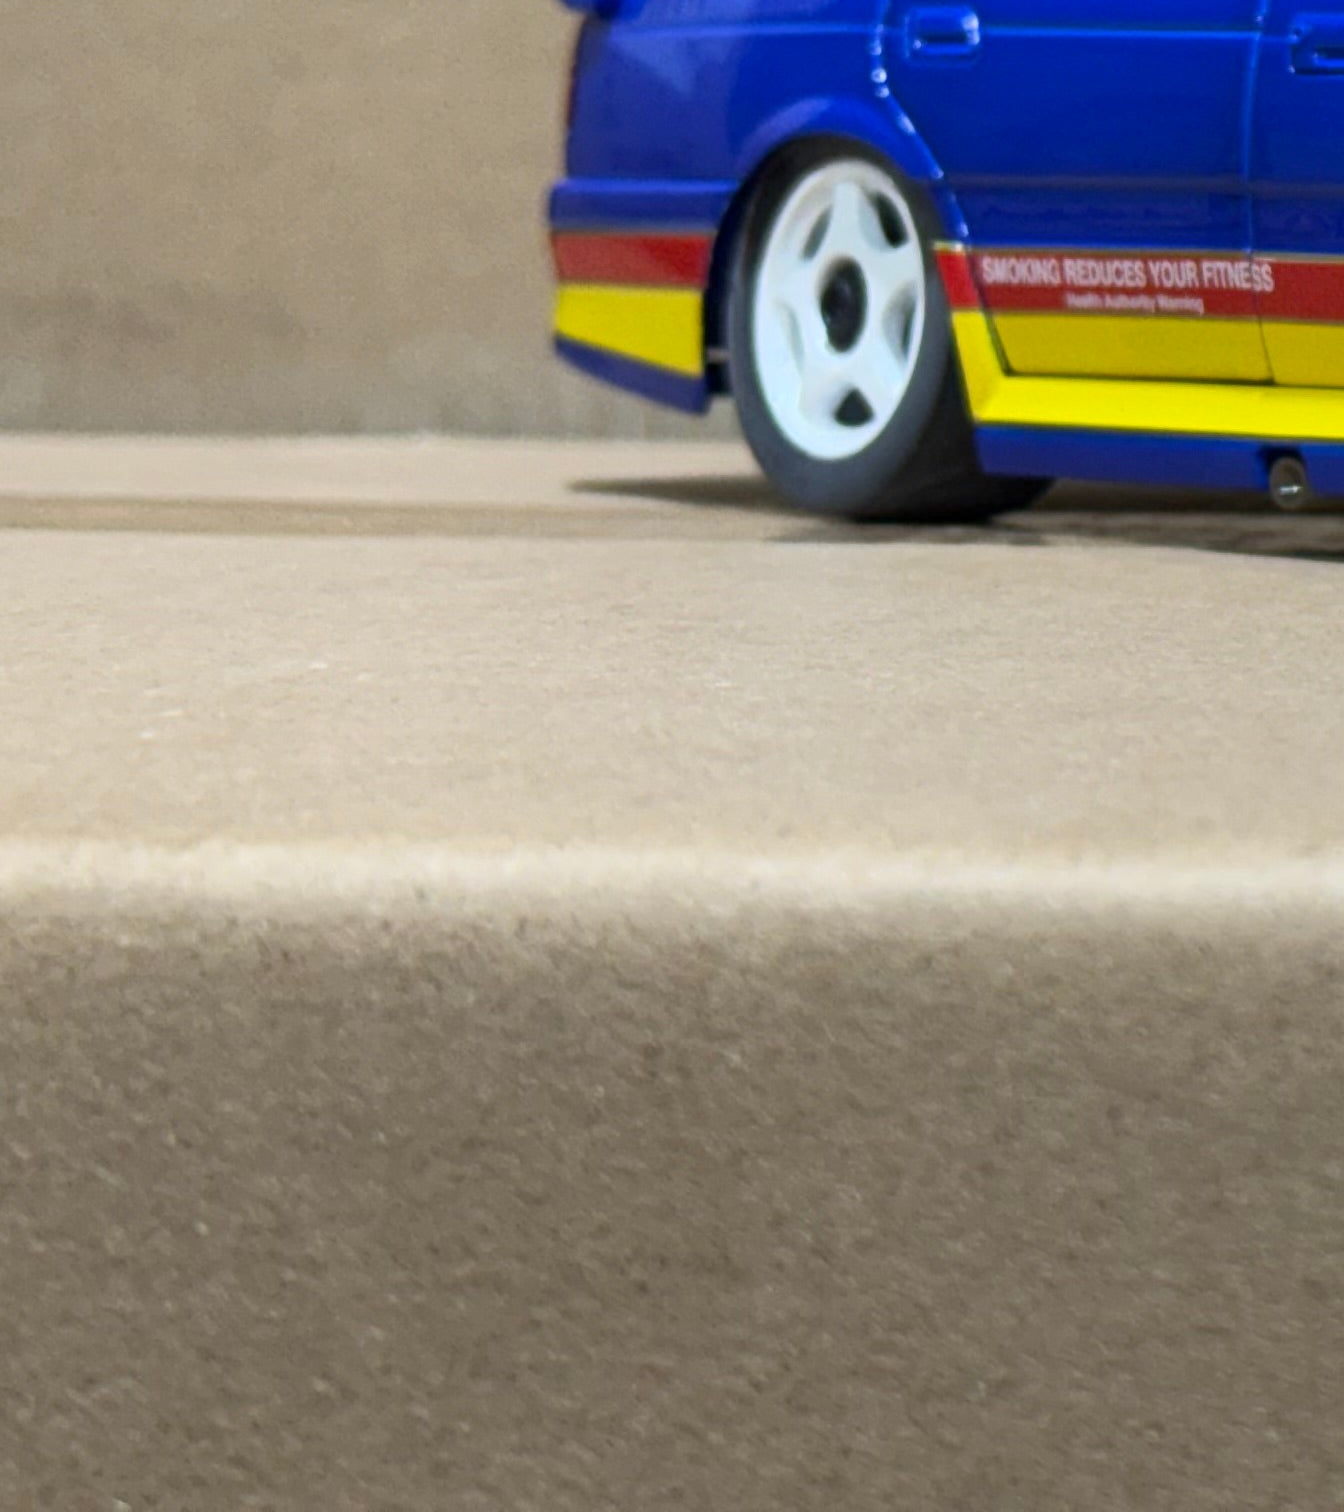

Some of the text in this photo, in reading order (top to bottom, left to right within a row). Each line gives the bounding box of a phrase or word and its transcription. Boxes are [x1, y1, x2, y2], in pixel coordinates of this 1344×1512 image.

[982, 256, 1275, 292] SMOKING REDUCES YOUR FITNESS
